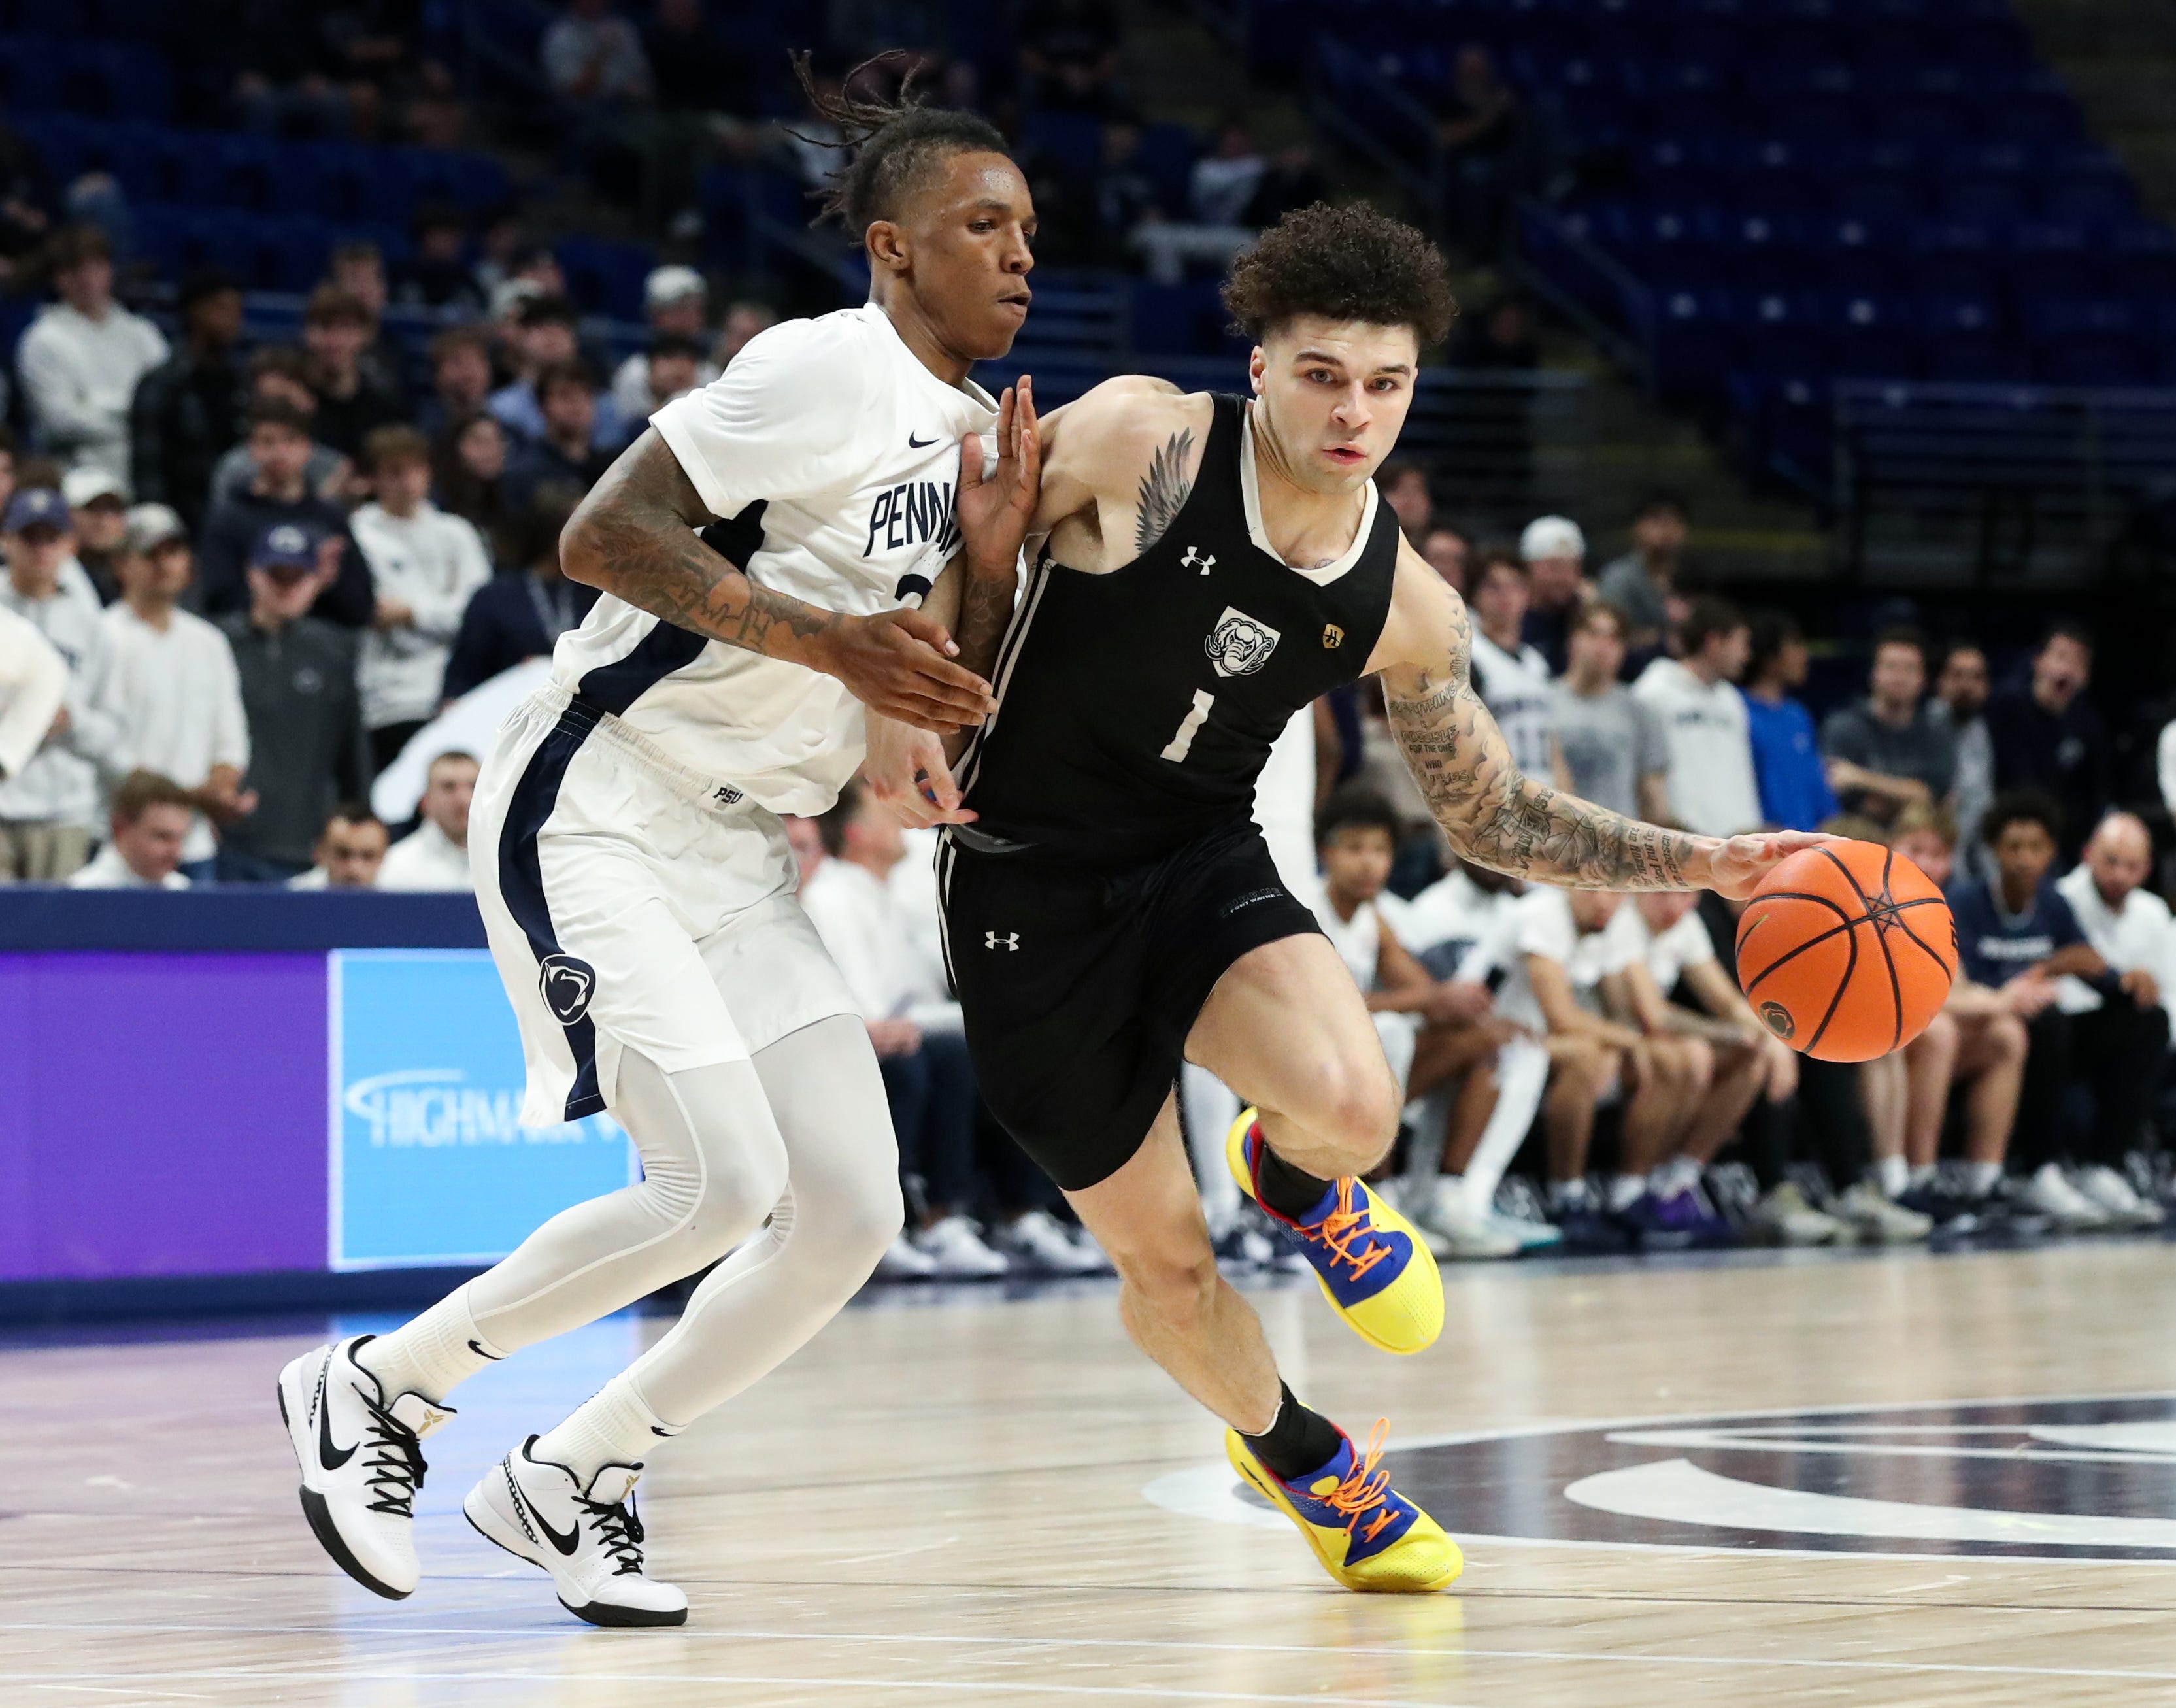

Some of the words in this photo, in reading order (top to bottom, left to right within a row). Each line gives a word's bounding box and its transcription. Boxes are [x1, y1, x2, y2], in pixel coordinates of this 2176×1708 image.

[863, 482, 950, 558] PENN
[1160, 688, 1215, 763] 1
[1409, 744, 1423, 754] FOR
[1424, 744, 1437, 753] THE
[1438, 742, 1455, 754] ONE
[1424, 760, 1443, 770] WHO
[712, 787, 743, 805] PSU
